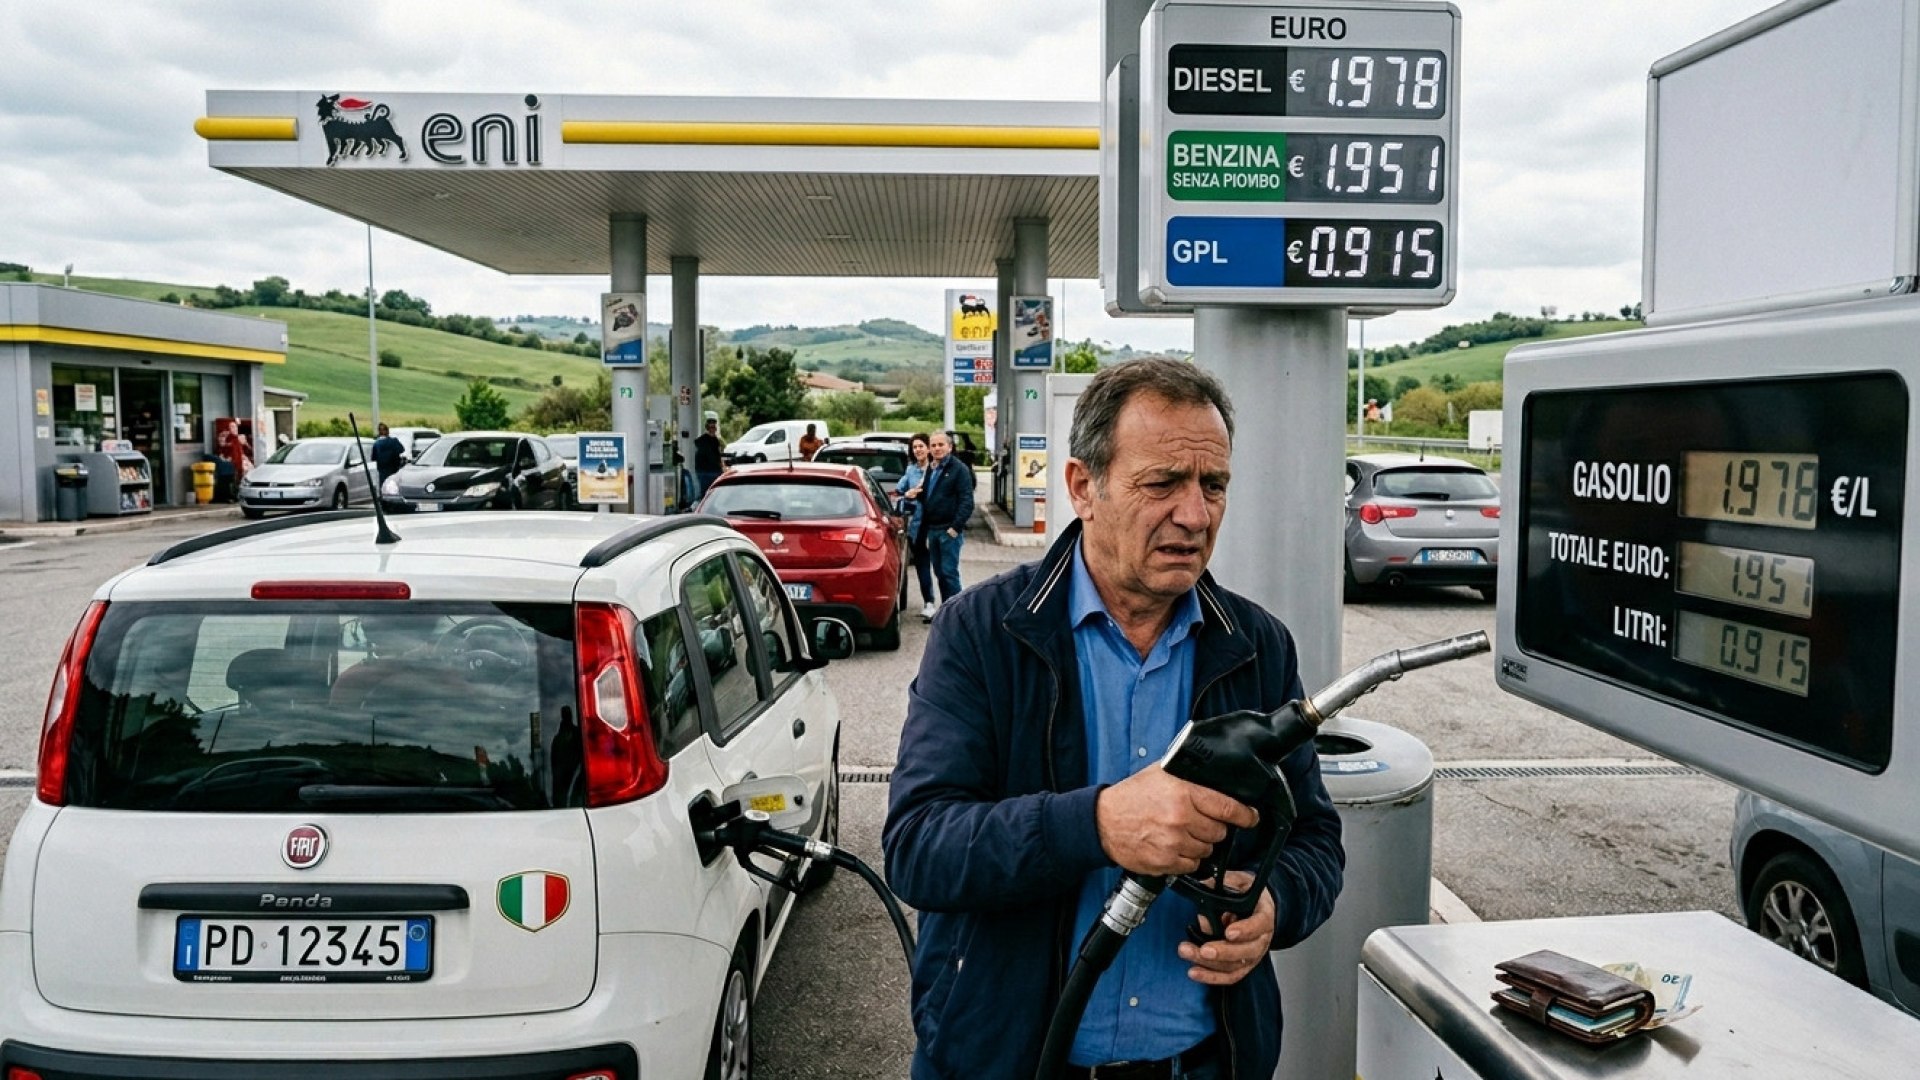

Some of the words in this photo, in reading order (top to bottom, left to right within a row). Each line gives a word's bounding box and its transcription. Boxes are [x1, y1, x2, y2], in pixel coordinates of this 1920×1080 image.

[1270, 15, 1347, 40] EURO
[1173, 67, 1272, 93] DIESEL
[1289, 69, 1305, 92] €
[1328, 56, 1442, 109] 1.978
[421, 93, 542, 165] eni
[1173, 144, 1280, 168] BENZINA
[1288, 155, 1304, 178] €
[1326, 142, 1440, 193] 1.951
[1173, 172, 1220, 188] SENZA
[1223, 173, 1280, 189] PIOMBO
[1172, 240, 1228, 264] GPL
[1286, 240, 1303, 264] €
[1308, 226, 1435, 278] 0.915
[1573, 460, 1671, 505] GASOLIO
[1723, 459, 1818, 521] 1.978
[1830, 475, 1877, 518] €/L
[1549, 532, 1609, 568] TOTALE
[1612, 541, 1670, 580] EURO:
[1732, 555, 1812, 607] 1.951
[1613, 605, 1667, 648] LITRI:
[1720, 624, 1809, 686] 0.915
[205, 925, 254, 966] PD
[277, 925, 400, 966] 12345
